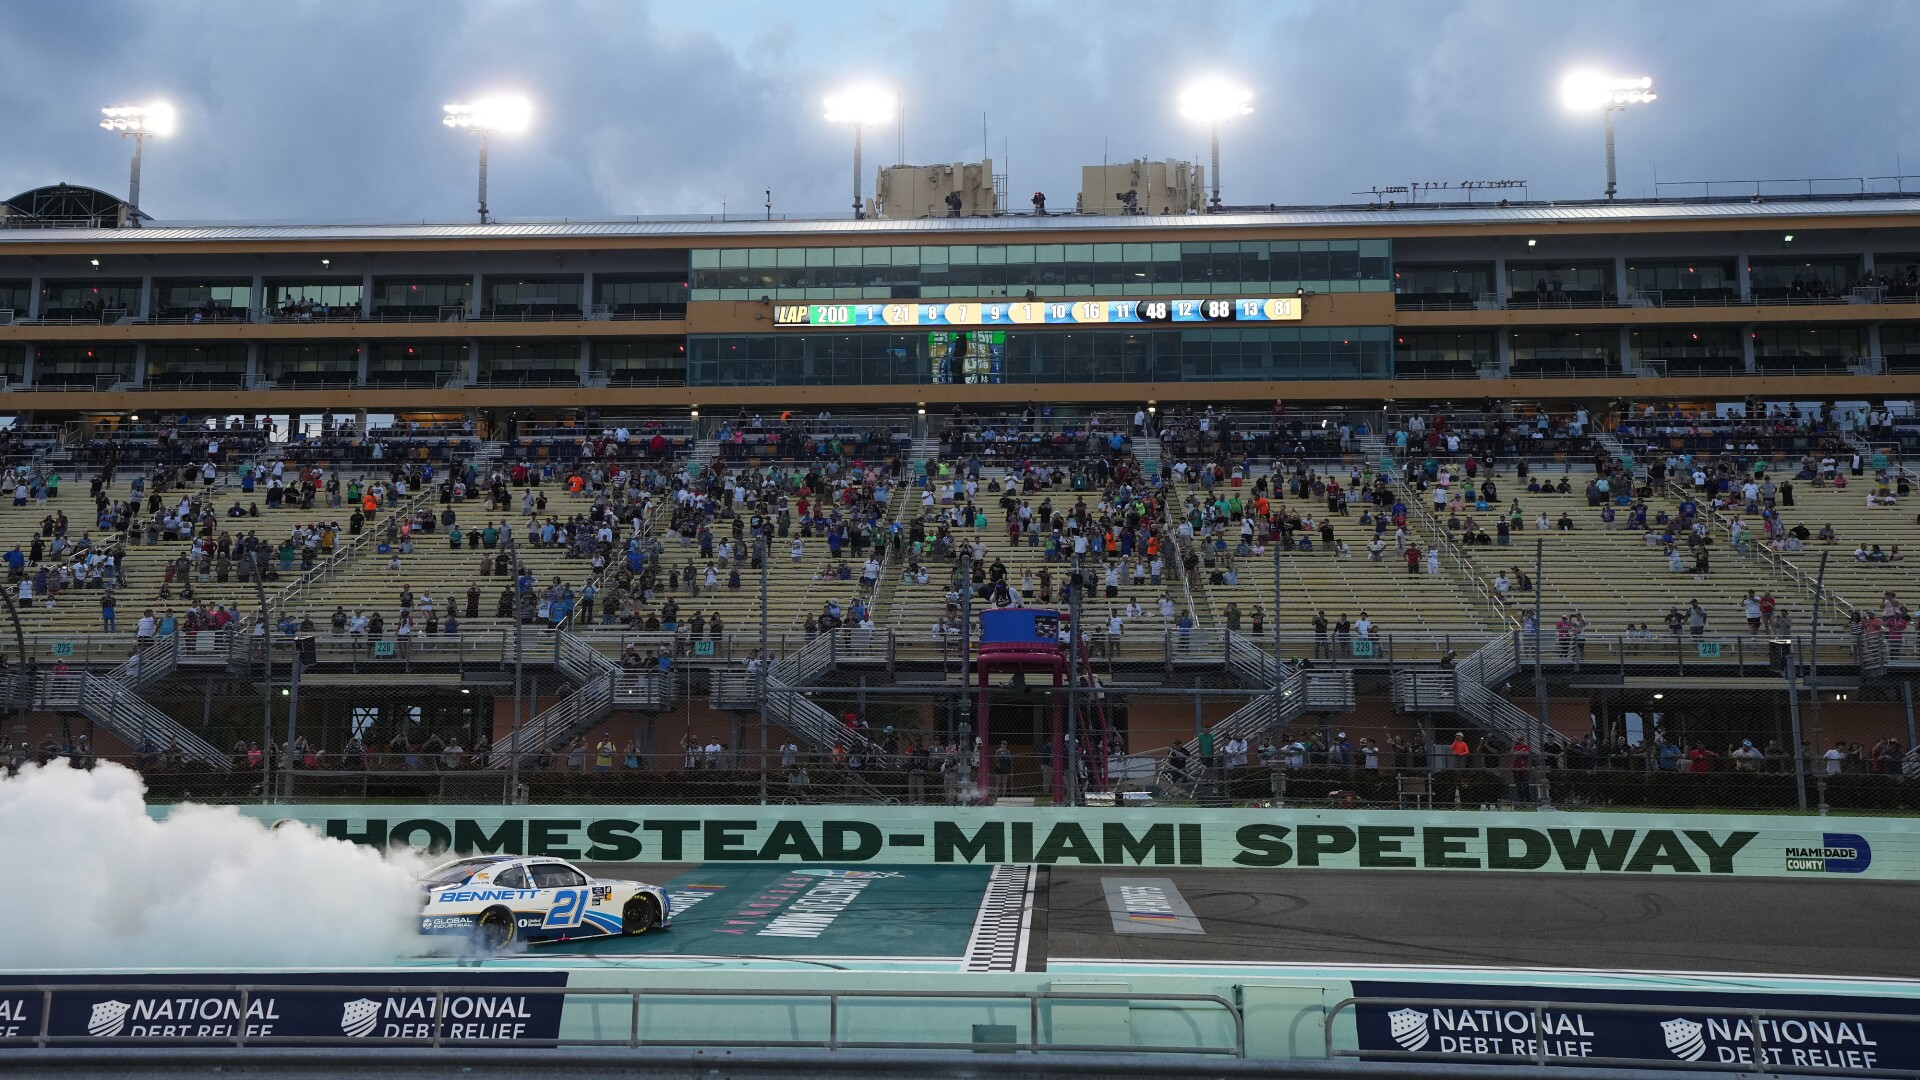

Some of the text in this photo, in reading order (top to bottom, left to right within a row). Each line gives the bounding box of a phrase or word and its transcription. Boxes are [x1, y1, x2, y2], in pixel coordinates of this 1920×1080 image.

[778, 300, 1291, 323] LAP 200 1 21 8 7 9 1 10 16 11 48 12 88 13 81
[57, 643, 70, 653] 225
[377, 642, 391, 653] 226
[698, 642, 711, 652] 227
[1355, 642, 1370, 653] 229
[1702, 643, 1717, 653] 230
[1232, 823, 1760, 873] SPEEDWAY
[1787, 860, 1823, 870] COUNTY
[438, 889, 541, 903] BENNETT
[545, 890, 590, 926] 21
[132, 998, 280, 1020] NATIONAL
[384, 996, 531, 1018] NATIONAL
[130, 1025, 273, 1037] DEBT RELEF
[450, 1023, 526, 1039] RELIEF
[1432, 1008, 1594, 1037] NATIONAL
[1706, 1018, 1877, 1046] NATIONAL
[1440, 1036, 1593, 1057] DEBT RELIEF
[1792, 1049, 1877, 1069] RELIEF
